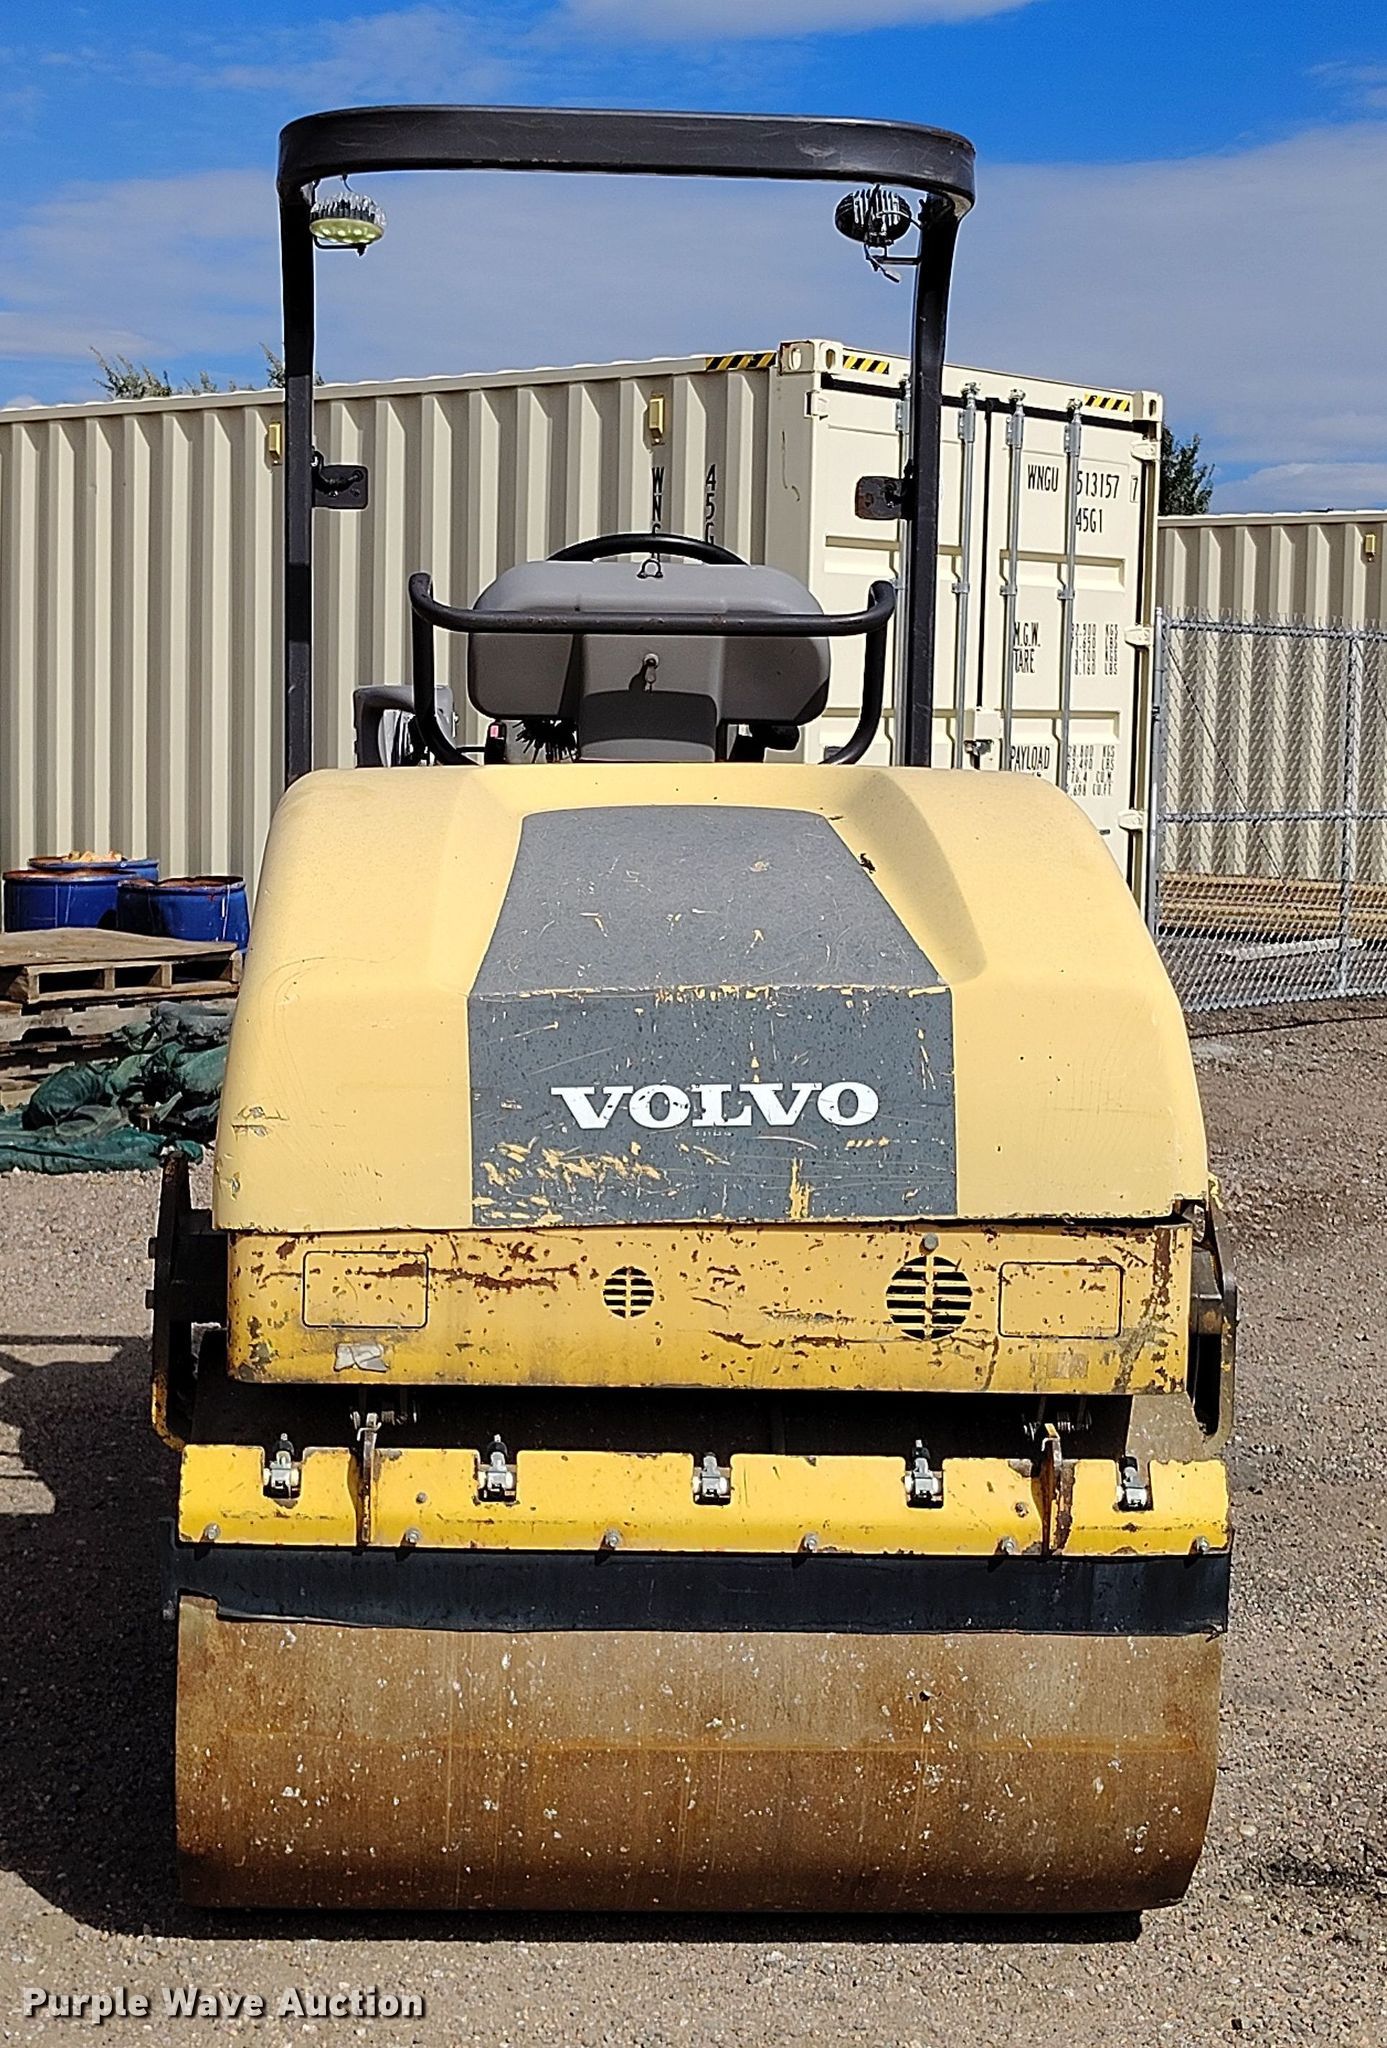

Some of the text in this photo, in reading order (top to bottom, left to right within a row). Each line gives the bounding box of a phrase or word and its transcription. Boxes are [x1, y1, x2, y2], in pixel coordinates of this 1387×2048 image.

[1027, 464, 1138, 501] WNGU 513157 7
[1076, 508, 1102, 533] 45G1
[1013, 621, 1041, 647] M.G.W.
[1012, 648, 1035, 673] TARE
[1009, 745, 1050, 771] PAYLOAD
[550, 1081, 879, 1129] VOLVO
